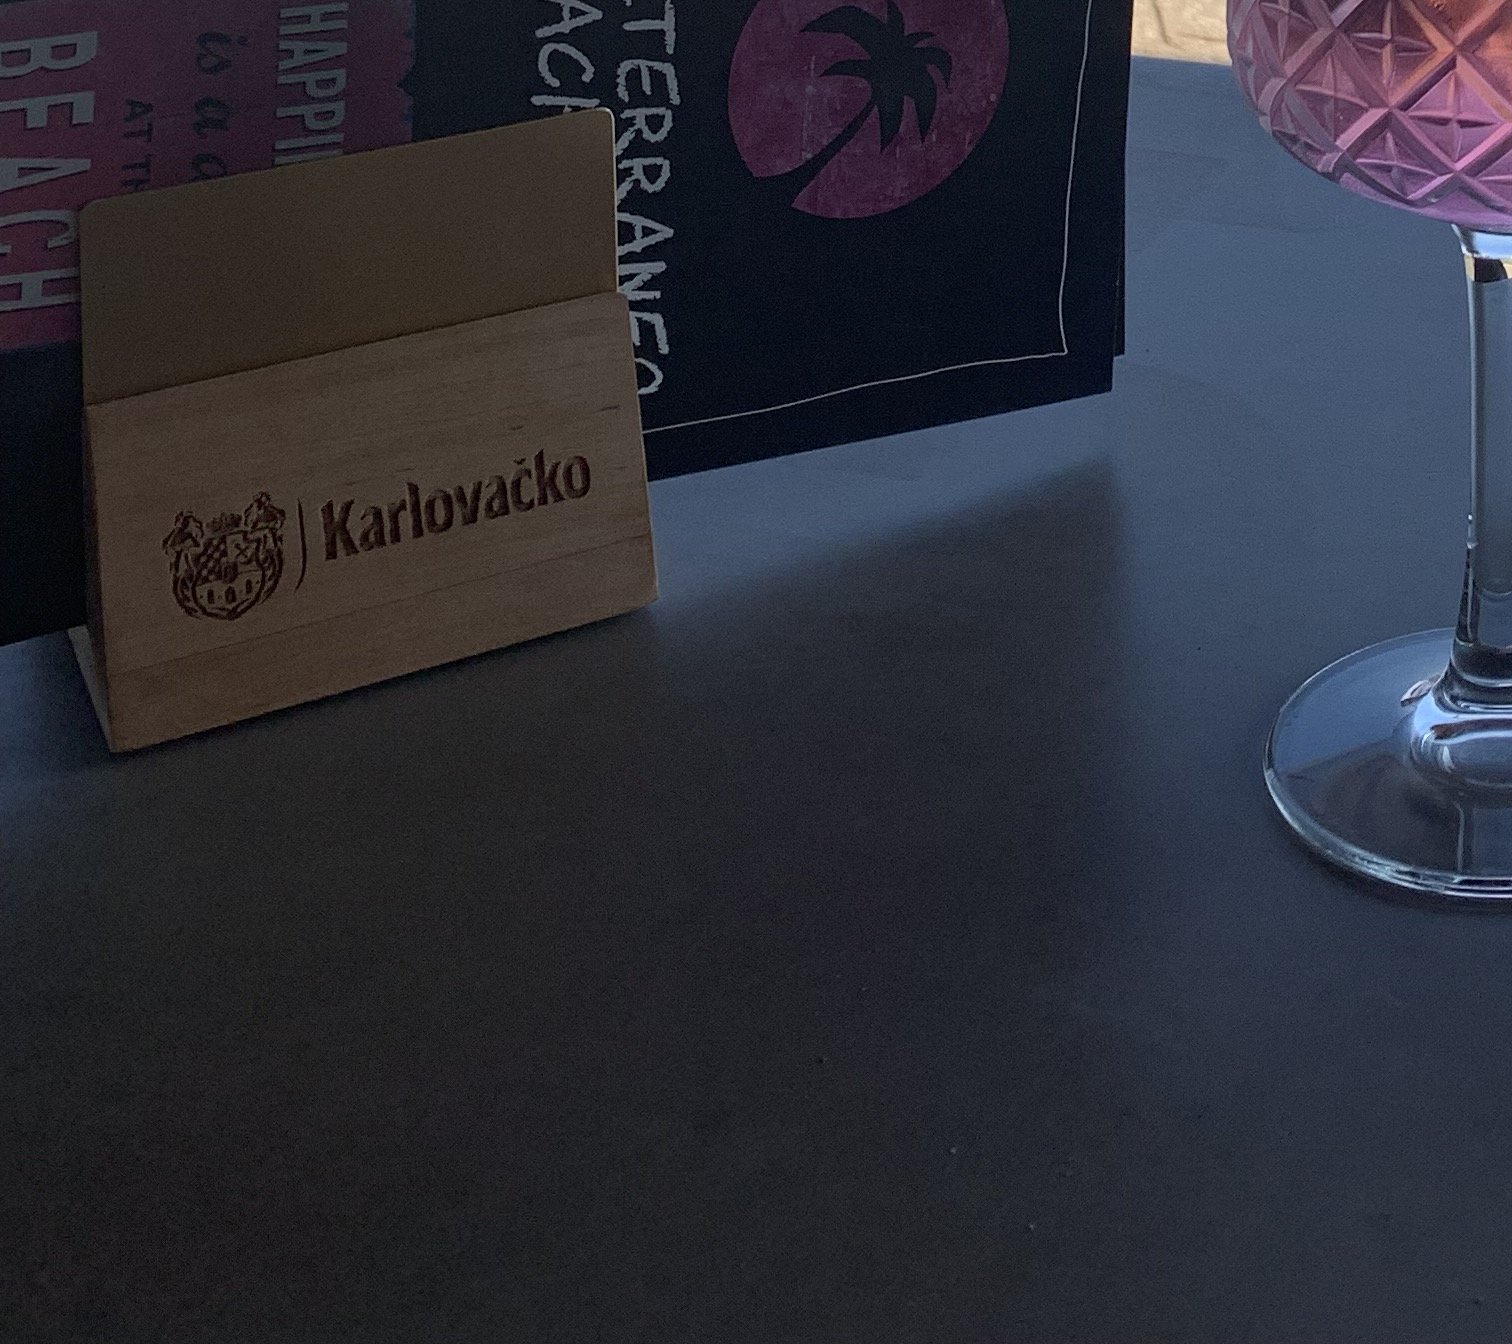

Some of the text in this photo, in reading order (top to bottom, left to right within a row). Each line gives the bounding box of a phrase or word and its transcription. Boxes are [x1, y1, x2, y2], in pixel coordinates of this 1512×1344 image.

[122, 98, 153, 143] AT
[273, 2, 349, 166] HAPPI
[320, 448, 591, 561] Karlovačko
